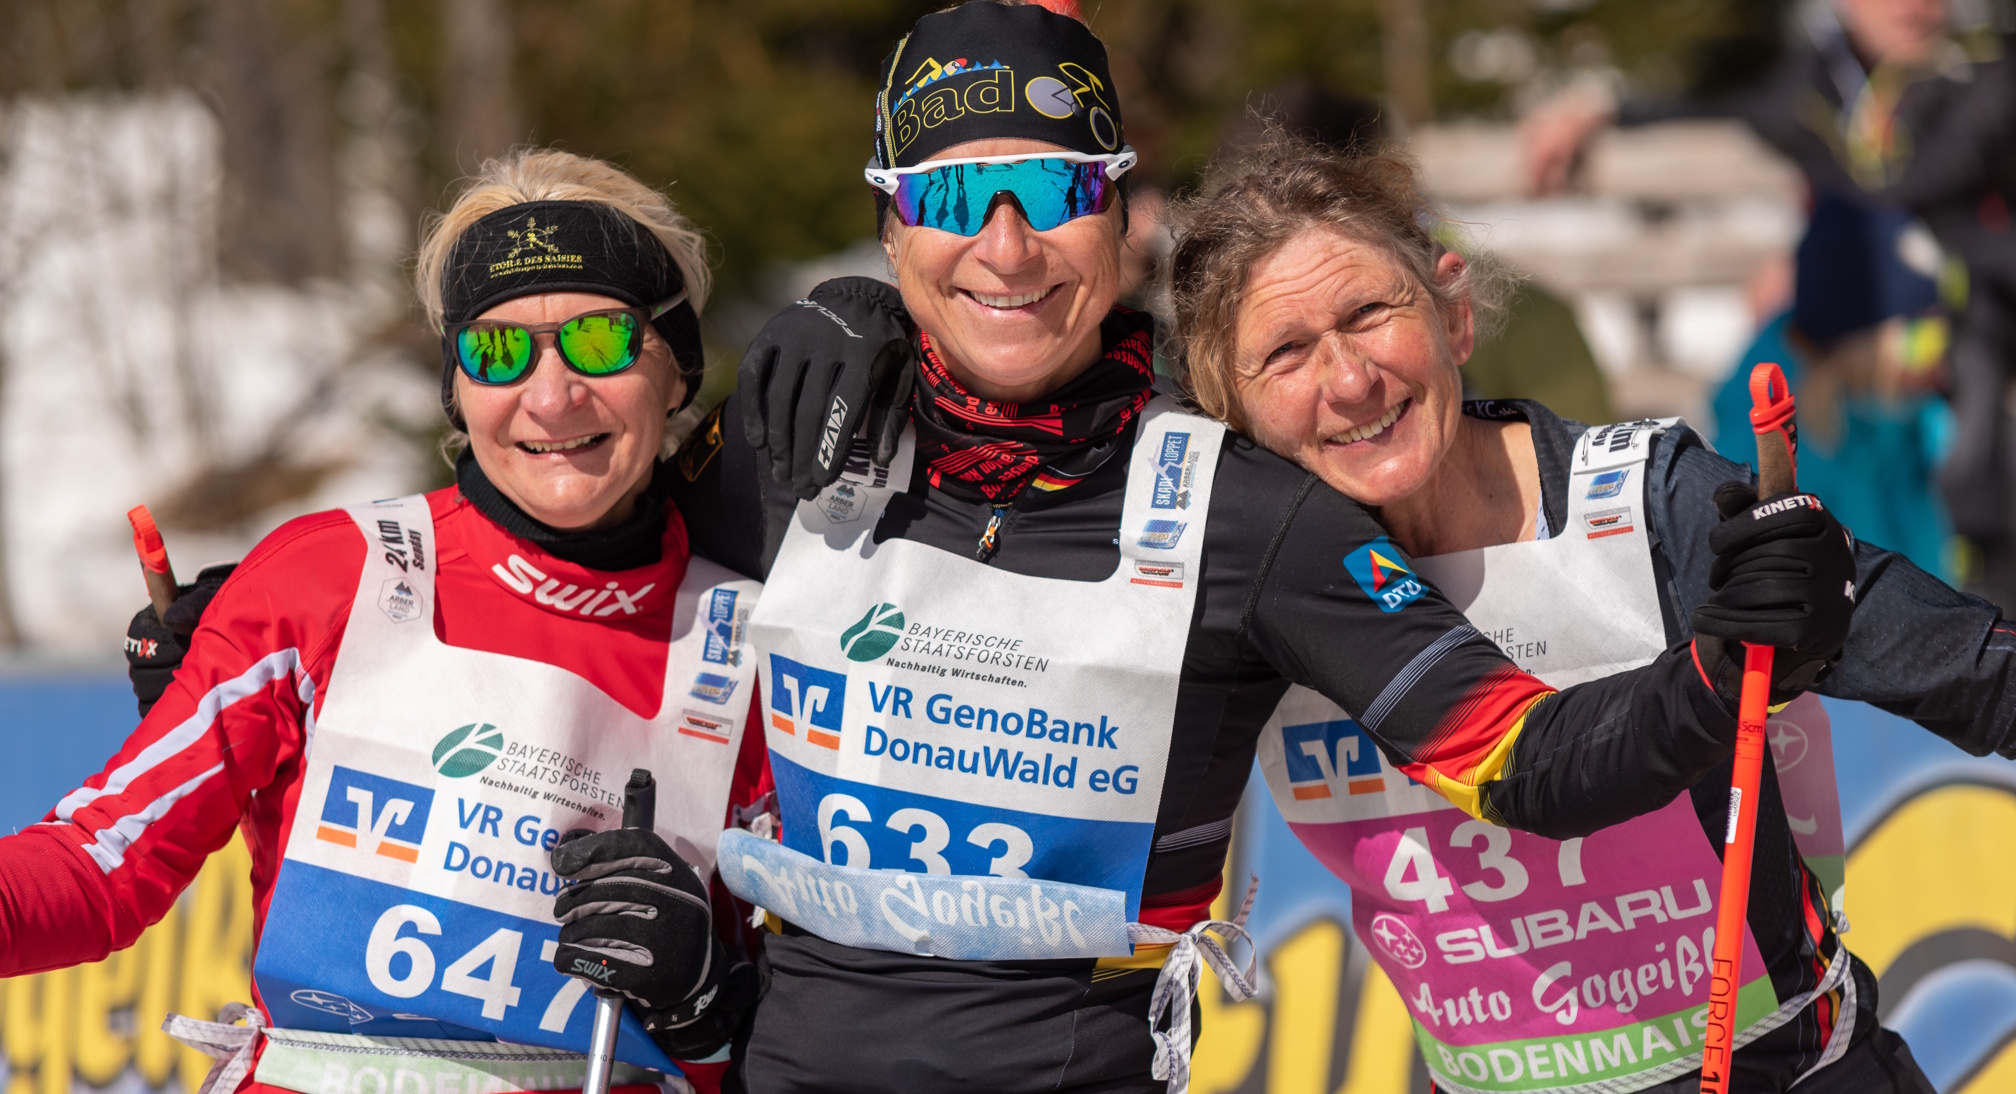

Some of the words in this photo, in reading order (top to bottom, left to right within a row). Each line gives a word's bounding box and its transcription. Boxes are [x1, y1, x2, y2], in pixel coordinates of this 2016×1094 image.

[890, 70, 1015, 158] Bad
[524, 255, 543, 266] DES
[544, 254, 583, 264] SAISIES
[1164, 435, 1183, 462] LOPPET
[828, 503, 850, 515] LAND
[829, 495, 854, 508] ARBER
[1156, 477, 1174, 506] SKADI
[389, 595, 414, 607] ARBER
[389, 603, 411, 614] LAND
[713, 590, 732, 619] LOPPET
[1382, 580, 1422, 609] DTU
[900, 637, 1050, 673] STAATSFORSTEN
[908, 622, 1024, 652] BAYERISCHE
[886, 657, 948, 678] Nachhaltig
[951, 668, 1028, 689] Wirtschaften.
[868, 681, 914, 719] VR
[926, 693, 1119, 750] GenoBank
[506, 741, 602, 785] BAYERISCHE
[864, 725, 1078, 789] DonauWald
[1088, 764, 1140, 795] eG
[479, 775, 540, 800] Nachhaltig
[543, 791, 606, 821] Wirtschaften.
[496, 757, 625, 810] STAATSFORSTEN
[457, 797, 504, 838] VR
[817, 793, 1035, 879] 633
[1436, 878, 1713, 965] SUBARU
[365, 904, 594, 1034] 647
[1411, 982, 1511, 1028] Auto
[1703, 957, 1733, 1065] FORCE
[1436, 1008, 1711, 1083] BODENMAIS
